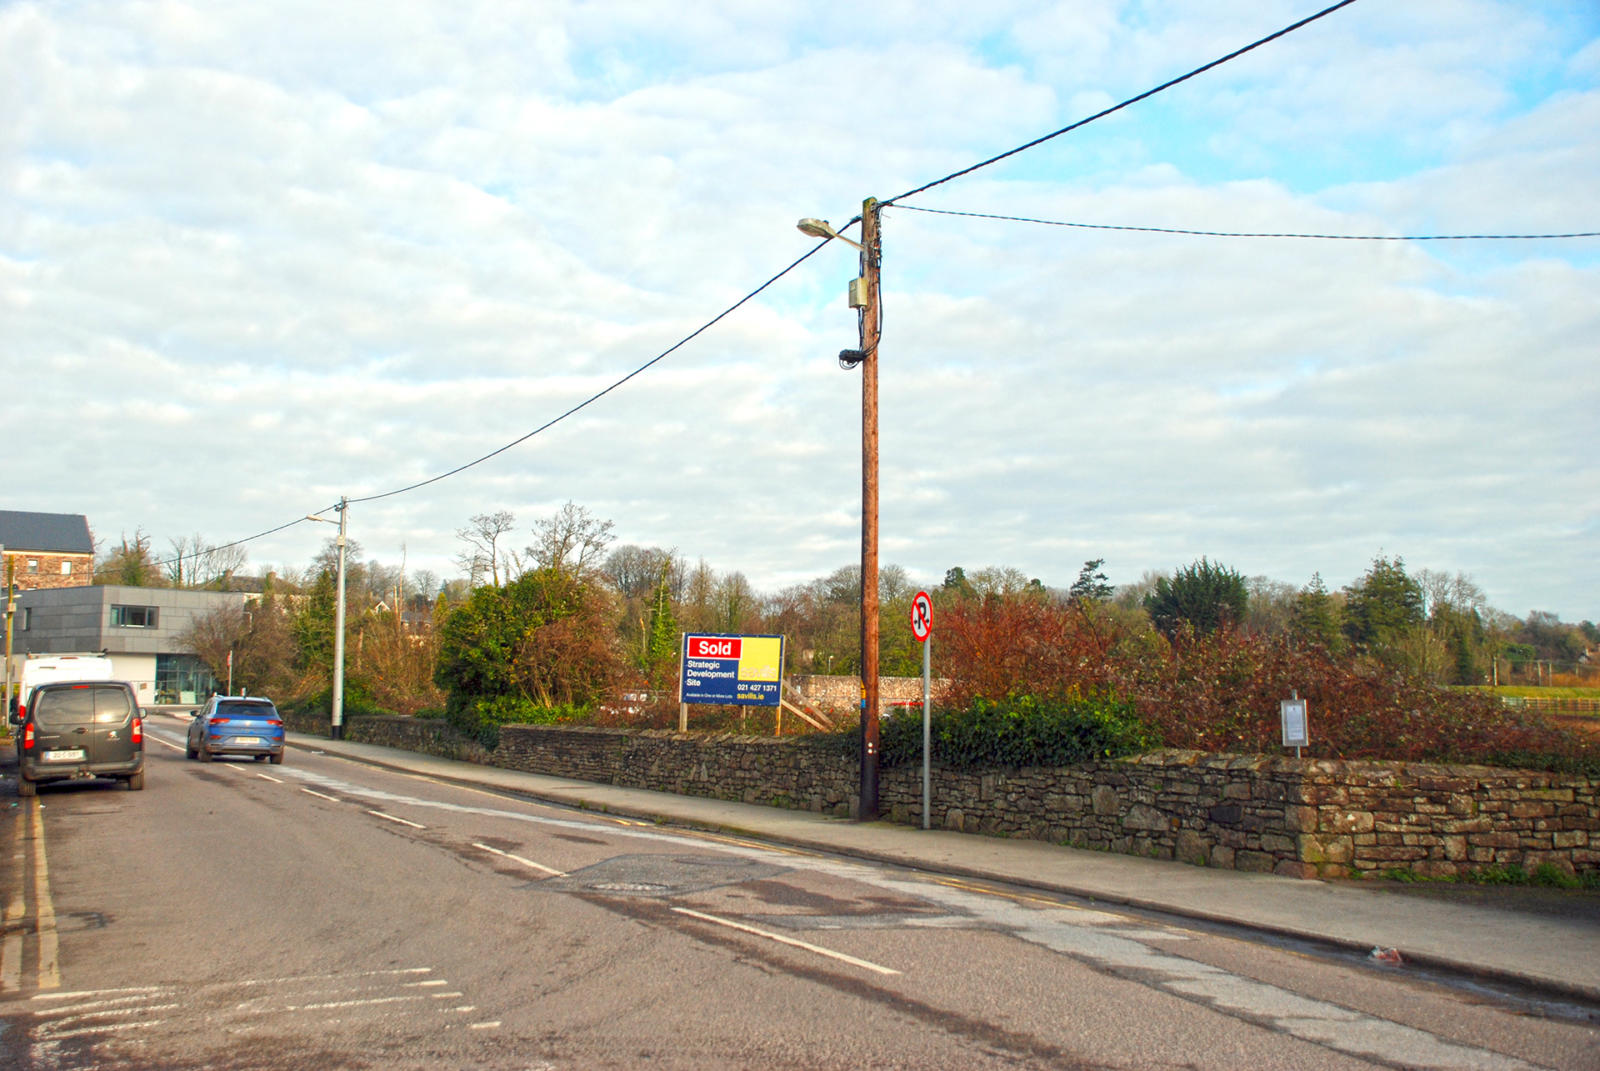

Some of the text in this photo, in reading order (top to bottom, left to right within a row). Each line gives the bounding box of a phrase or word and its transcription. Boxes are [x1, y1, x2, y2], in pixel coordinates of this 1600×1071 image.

[699, 641, 731, 655] Sold
[688, 660, 720, 670] Strategic
[687, 669, 735, 679] Development
[687, 678, 701, 686] Site
[737, 683, 748, 691] 021
[737, 692, 765, 700] savills.ie
